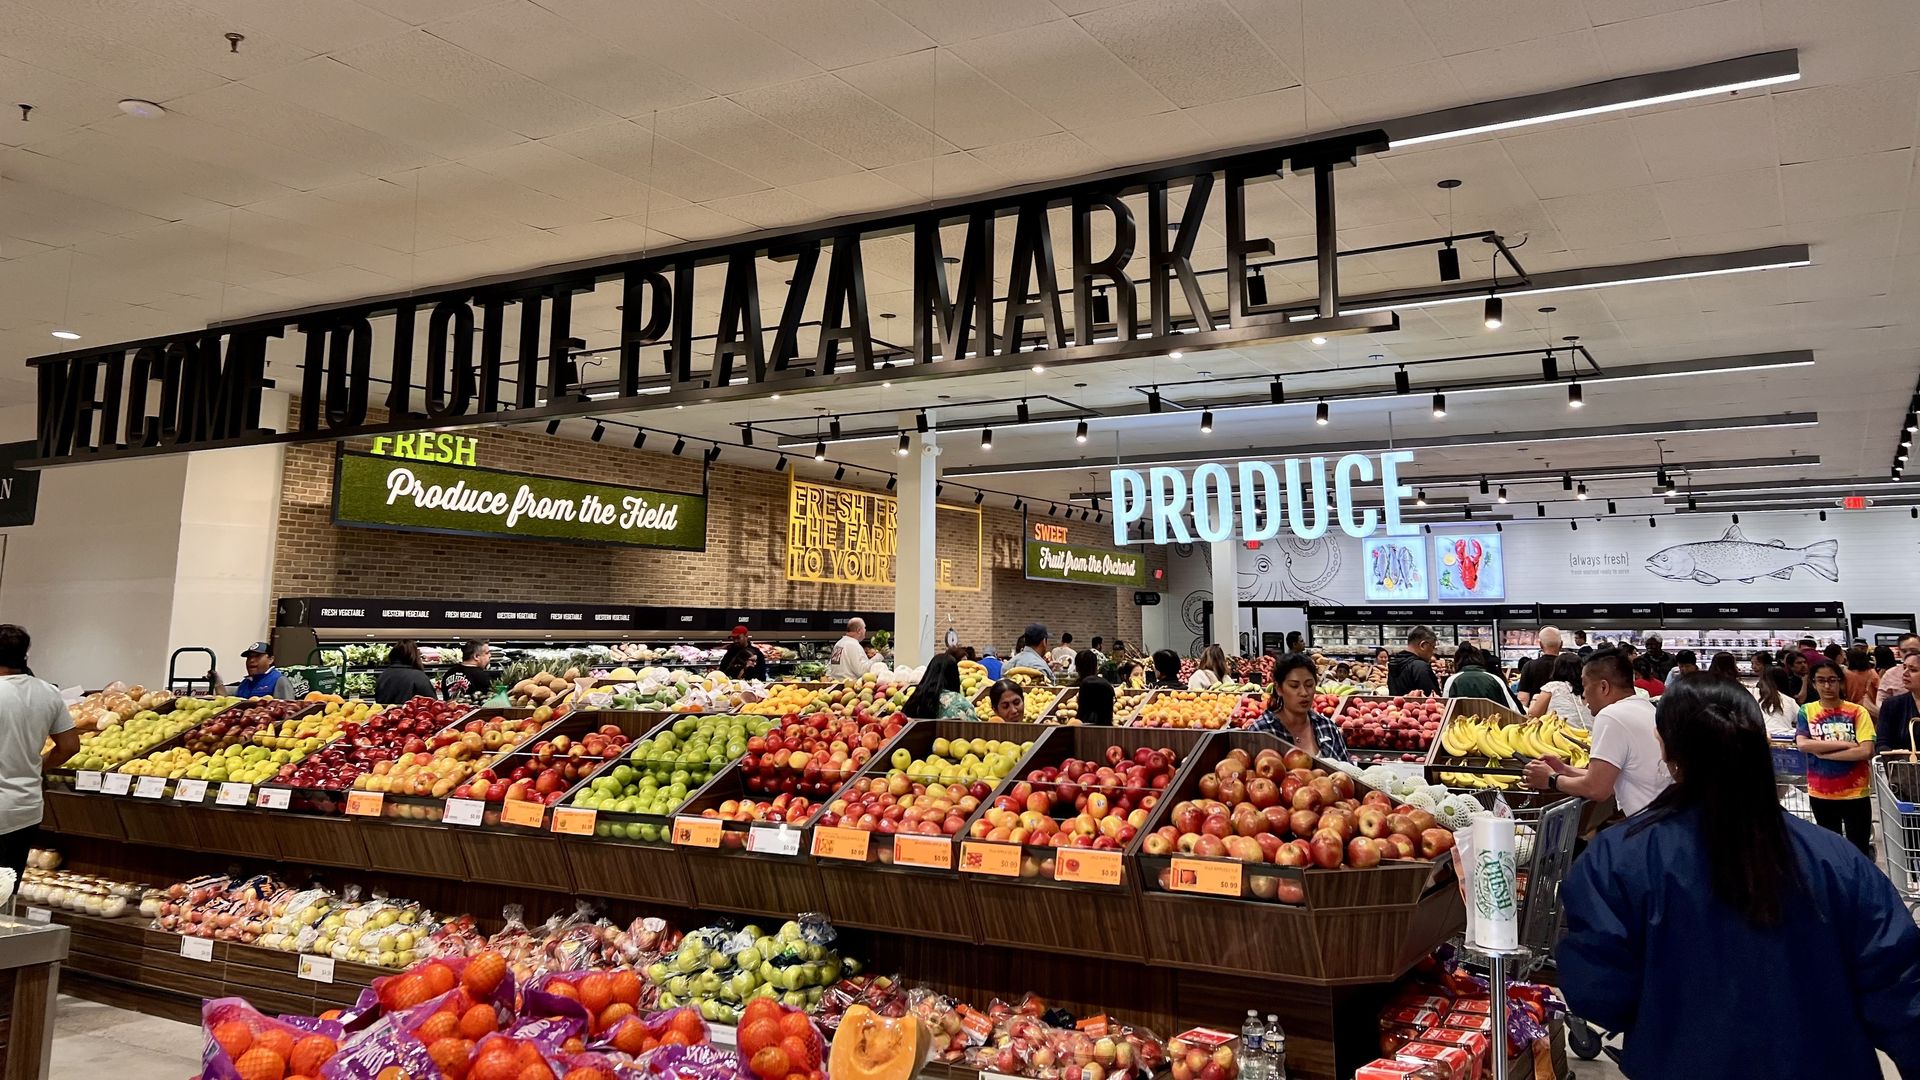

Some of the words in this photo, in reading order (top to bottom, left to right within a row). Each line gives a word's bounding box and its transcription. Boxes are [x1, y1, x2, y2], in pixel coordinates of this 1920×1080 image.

[37, 326, 285, 458] WELCOME
[298, 313, 372, 433] TO
[389, 283, 595, 422] LOTTE
[619, 236, 874, 398] PLAZA
[913, 152, 1358, 364] MARKET
[370, 432, 478, 467] FRESH
[386, 467, 508, 515] Produce
[507, 485, 577, 528] from
[579, 496, 616, 525] the
[620, 496, 678, 532] Field
[794, 485, 868, 523] FRESH
[875, 495, 897, 528] FR
[1110, 450, 1420, 546] PRODUCE
[791, 516, 838, 550] THE
[1035, 523, 1068, 544] SWEET
[789, 547, 824, 580] TO
[831, 551, 890, 583] YOUR
[1040, 547, 1064, 570] Fruit
[1064, 551, 1087, 576] from
[1088, 555, 1102, 574] the
[1103, 555, 1136, 577] Orchard
[321, 608, 338, 616] FRESH
[339, 609, 365, 617] VEGETABLE
[405, 610, 430, 618] VEGETABLE
[445, 611, 459, 619] FRESH
[1101, 869, 1118, 878] $0.99
[1220, 881, 1238, 889] $0.99
[1485, 861, 1512, 909] FRESH
